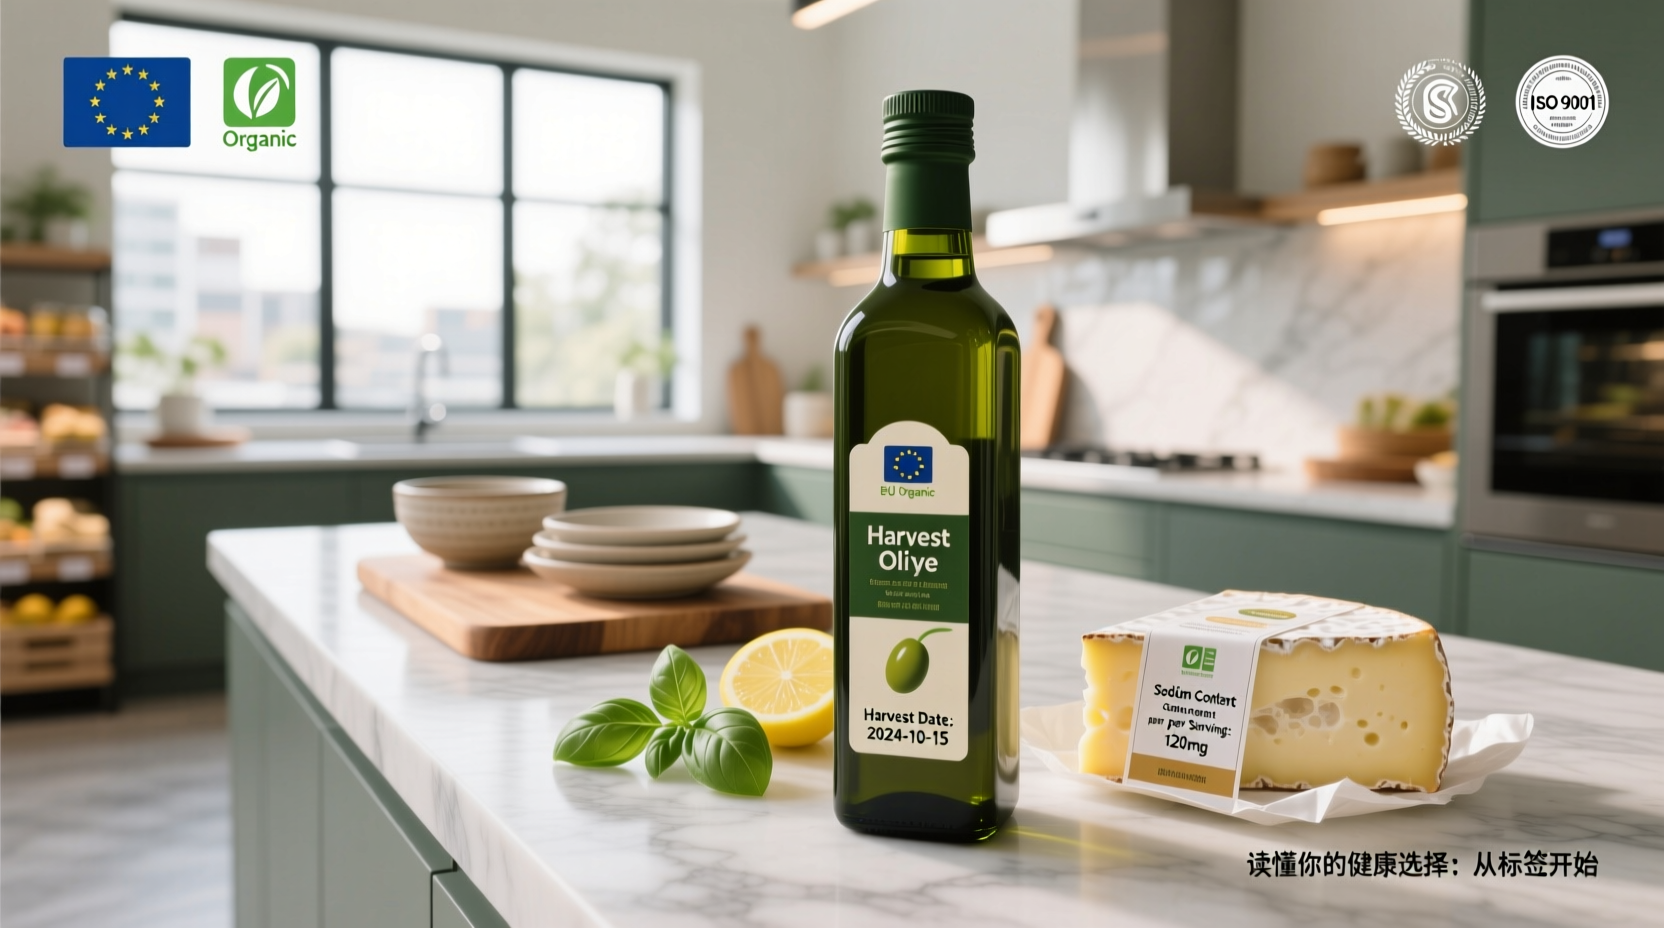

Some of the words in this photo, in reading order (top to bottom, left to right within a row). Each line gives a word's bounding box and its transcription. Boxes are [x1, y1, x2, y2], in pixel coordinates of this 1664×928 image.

[899, 486, 936, 499] Organic
[867, 525, 951, 547] Harvest
[864, 707, 915, 723] Harvest
[918, 711, 954, 727] Date:
[867, 726, 949, 746] 2024-10-15
[1165, 733, 1209, 757] 120mg
